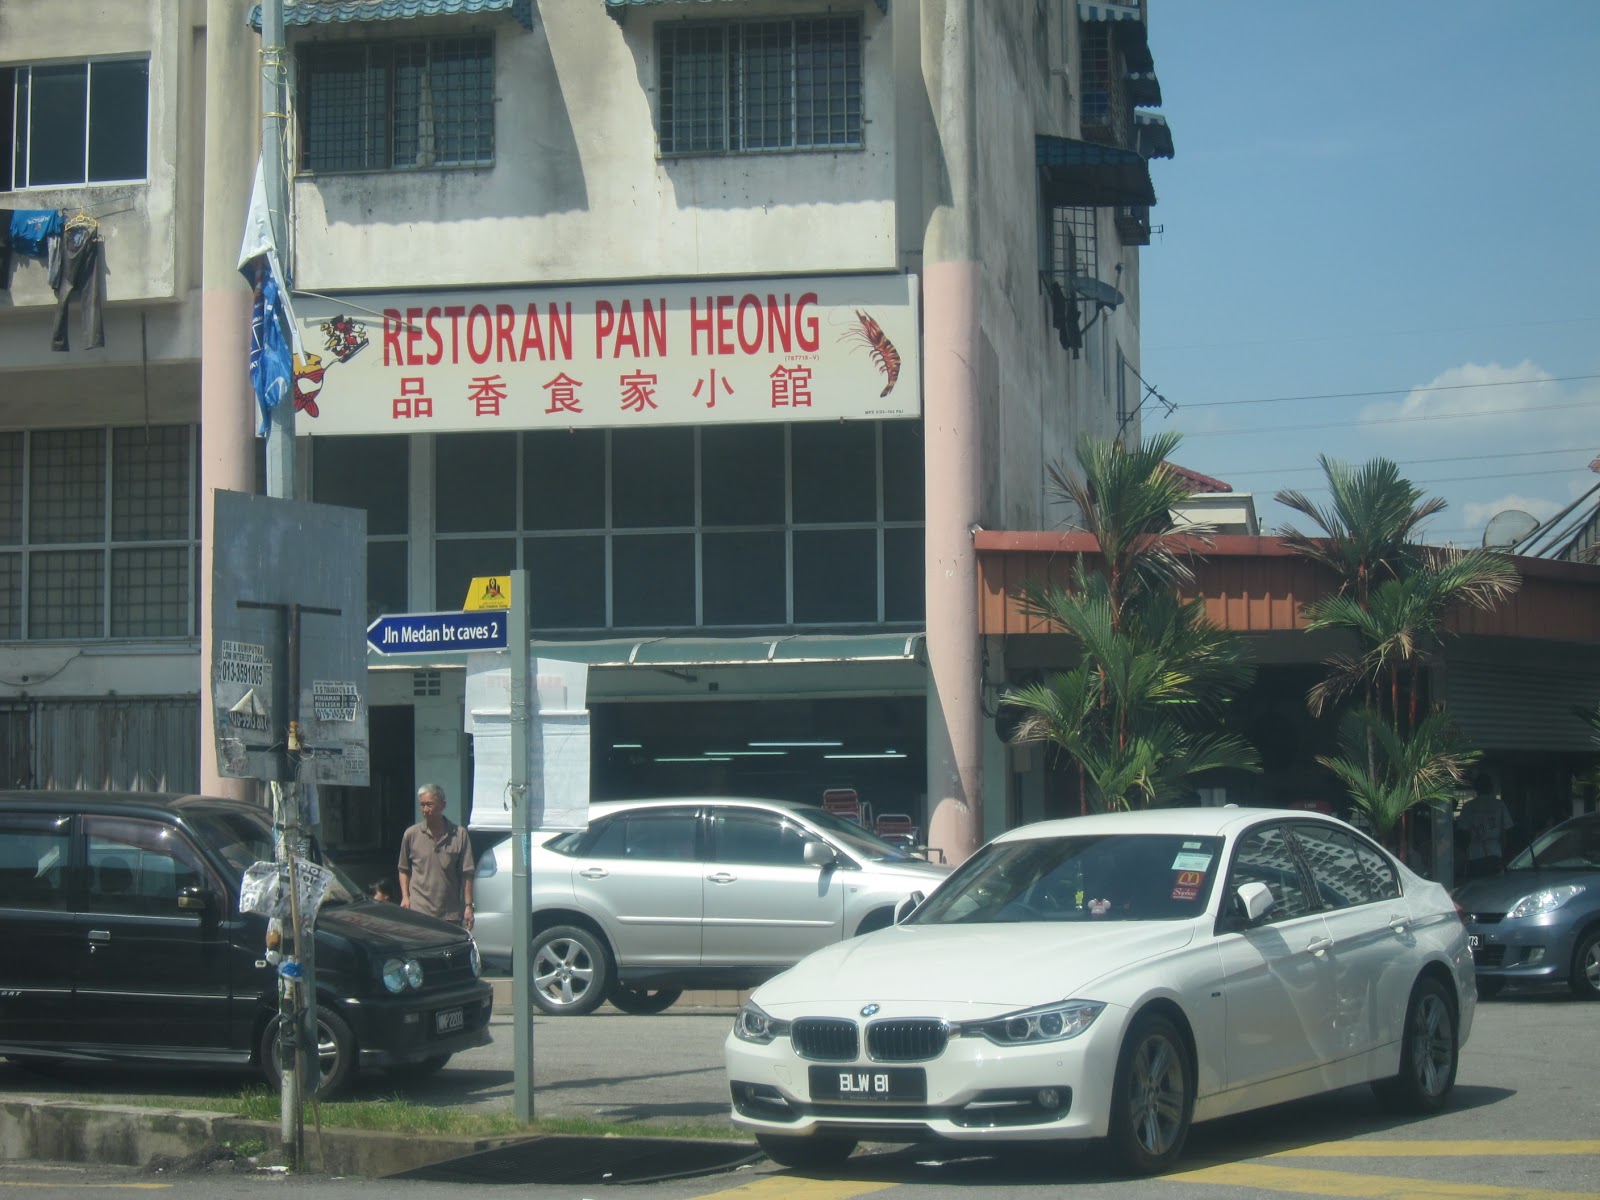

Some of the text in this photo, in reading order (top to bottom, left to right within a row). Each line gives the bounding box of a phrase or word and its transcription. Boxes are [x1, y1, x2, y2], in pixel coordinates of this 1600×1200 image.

[383, 291, 820, 367] RESTORAN PAN HEONG
[391, 363, 813, 420] 品香食家小館
[382, 621, 499, 644] Jln Medan bt caves 2
[840, 1073, 889, 1093] BLW 81
